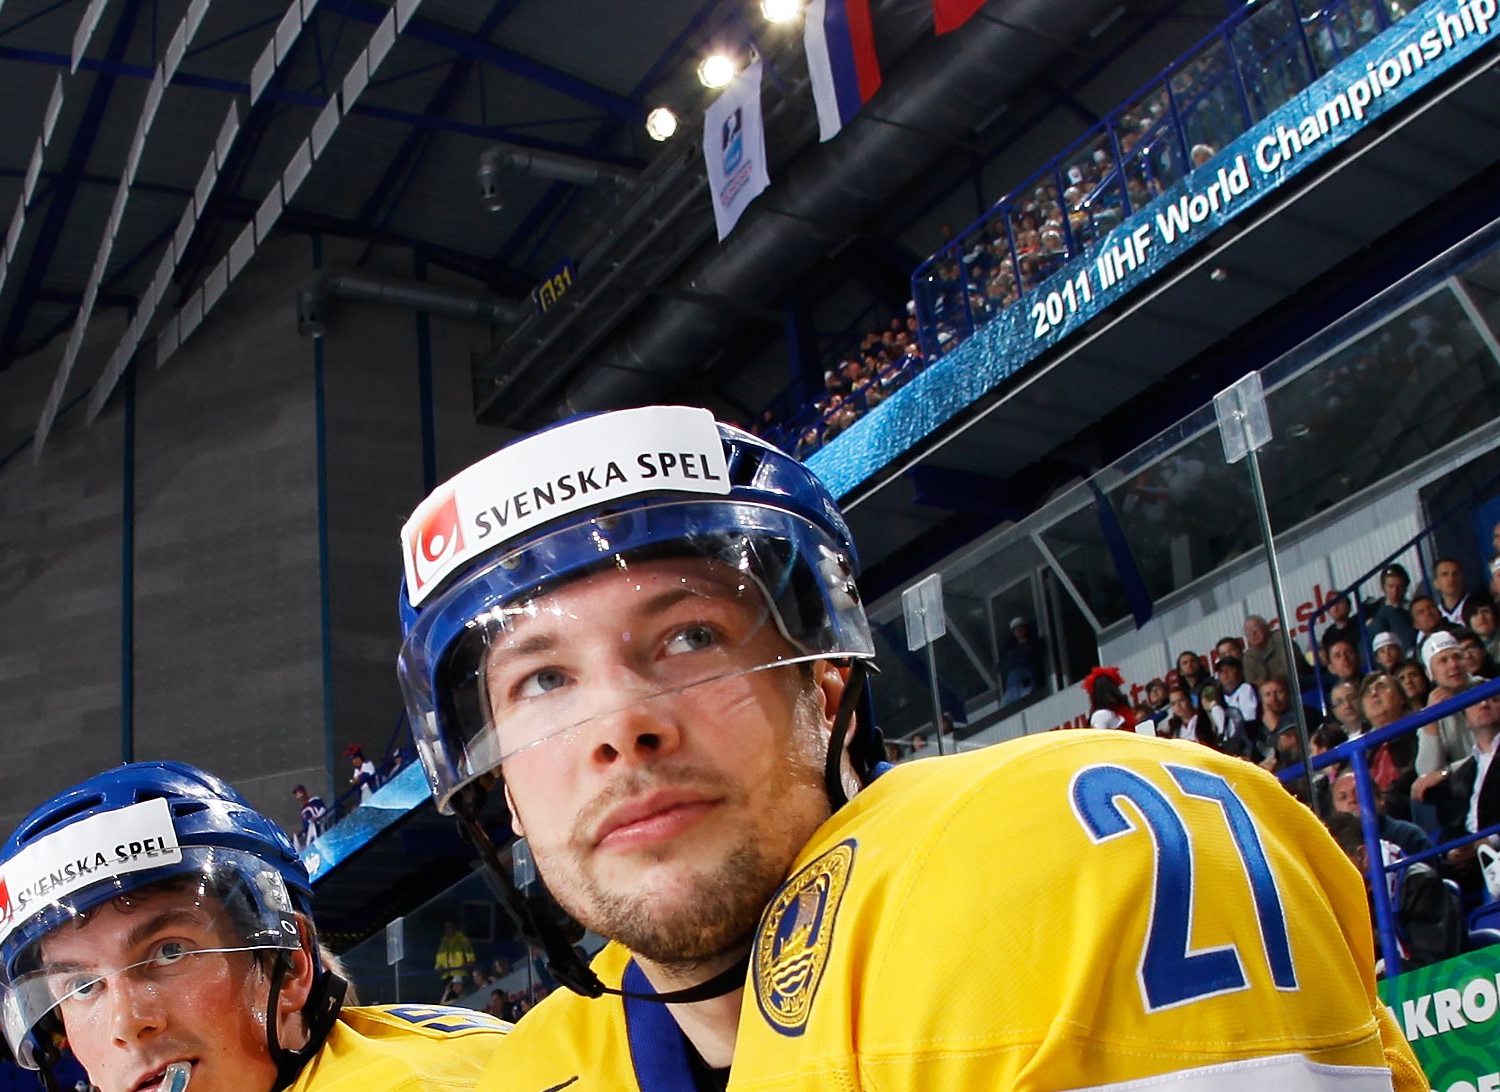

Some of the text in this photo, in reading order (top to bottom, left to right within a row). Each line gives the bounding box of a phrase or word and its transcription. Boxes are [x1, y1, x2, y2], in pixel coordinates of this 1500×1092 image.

[1031, 0, 1500, 340] 2011 IIHF World Championship
[474, 452, 721, 540] SVENSKA SPEL
[114, 836, 174, 864] SPEL
[1068, 762, 1300, 1014] 27
[1385, 973, 1500, 1042] KRO
